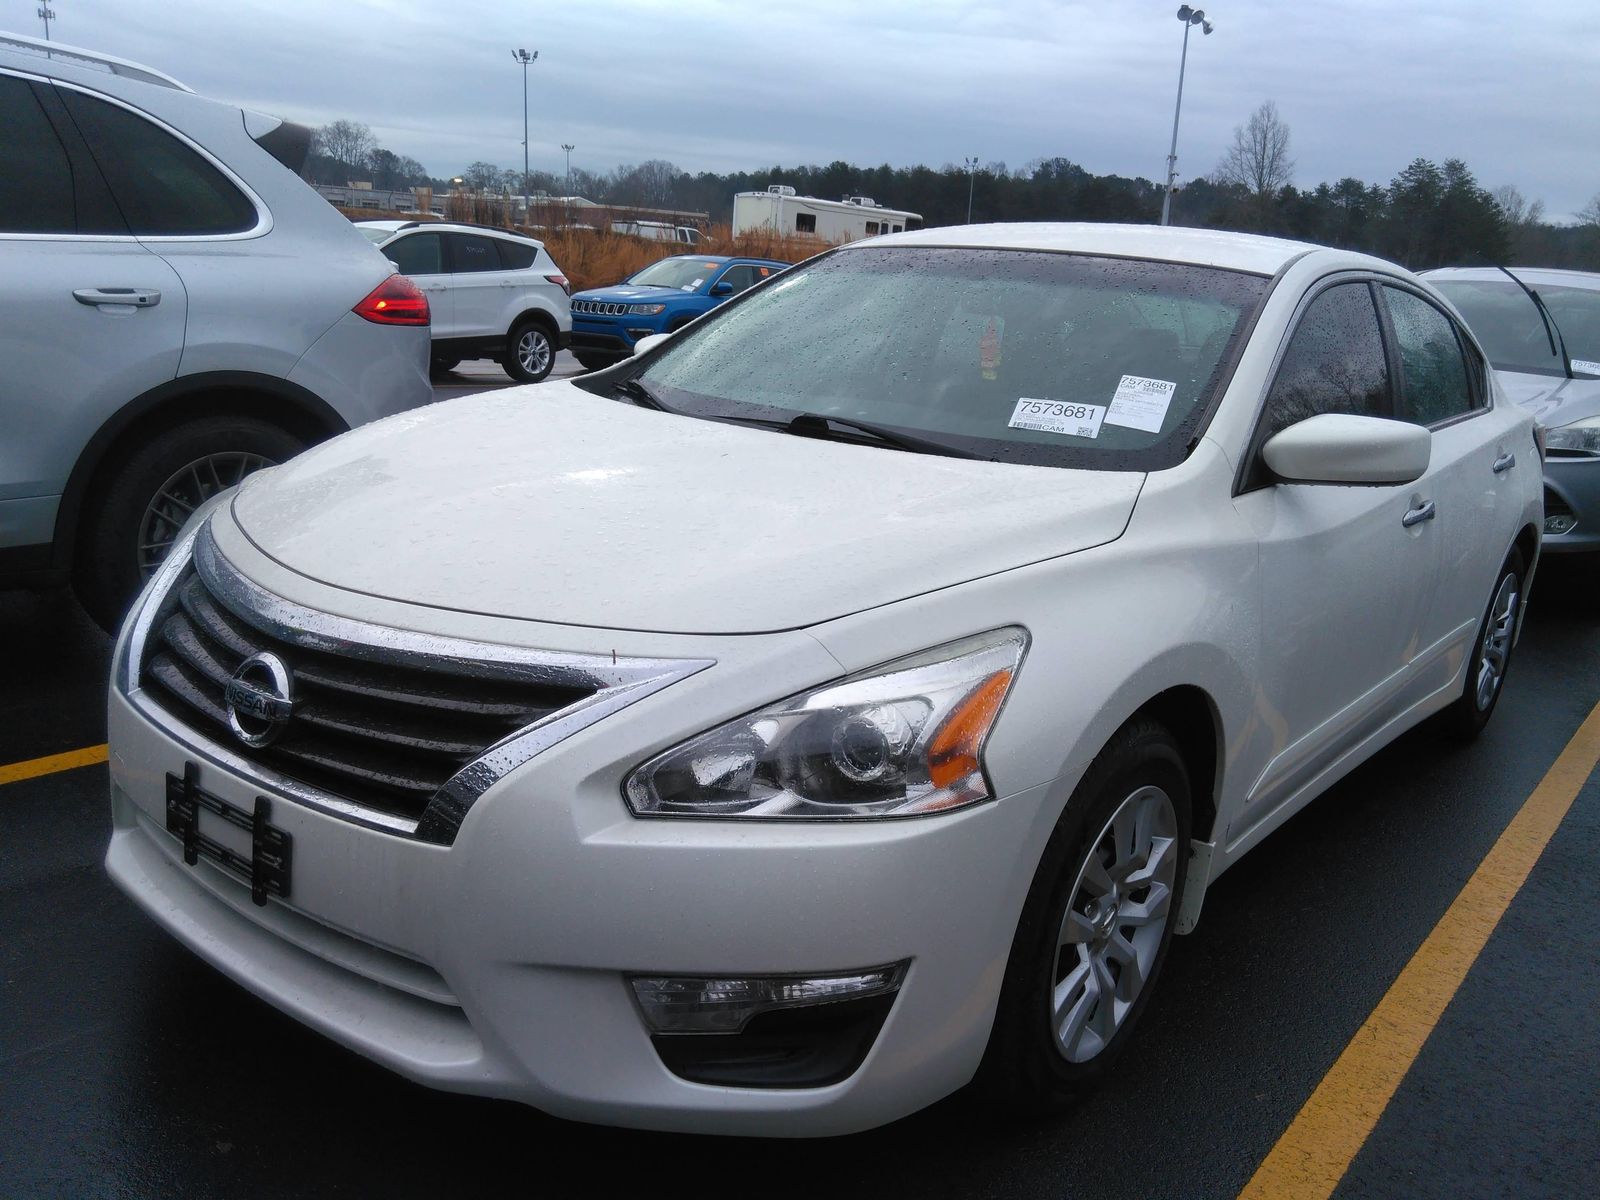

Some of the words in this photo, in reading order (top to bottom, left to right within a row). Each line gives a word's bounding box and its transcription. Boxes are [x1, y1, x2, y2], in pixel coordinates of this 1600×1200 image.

[1121, 376, 1174, 391] 7573681
[1020, 400, 1096, 420] 7573681
[1041, 425, 1065, 433] CAM
